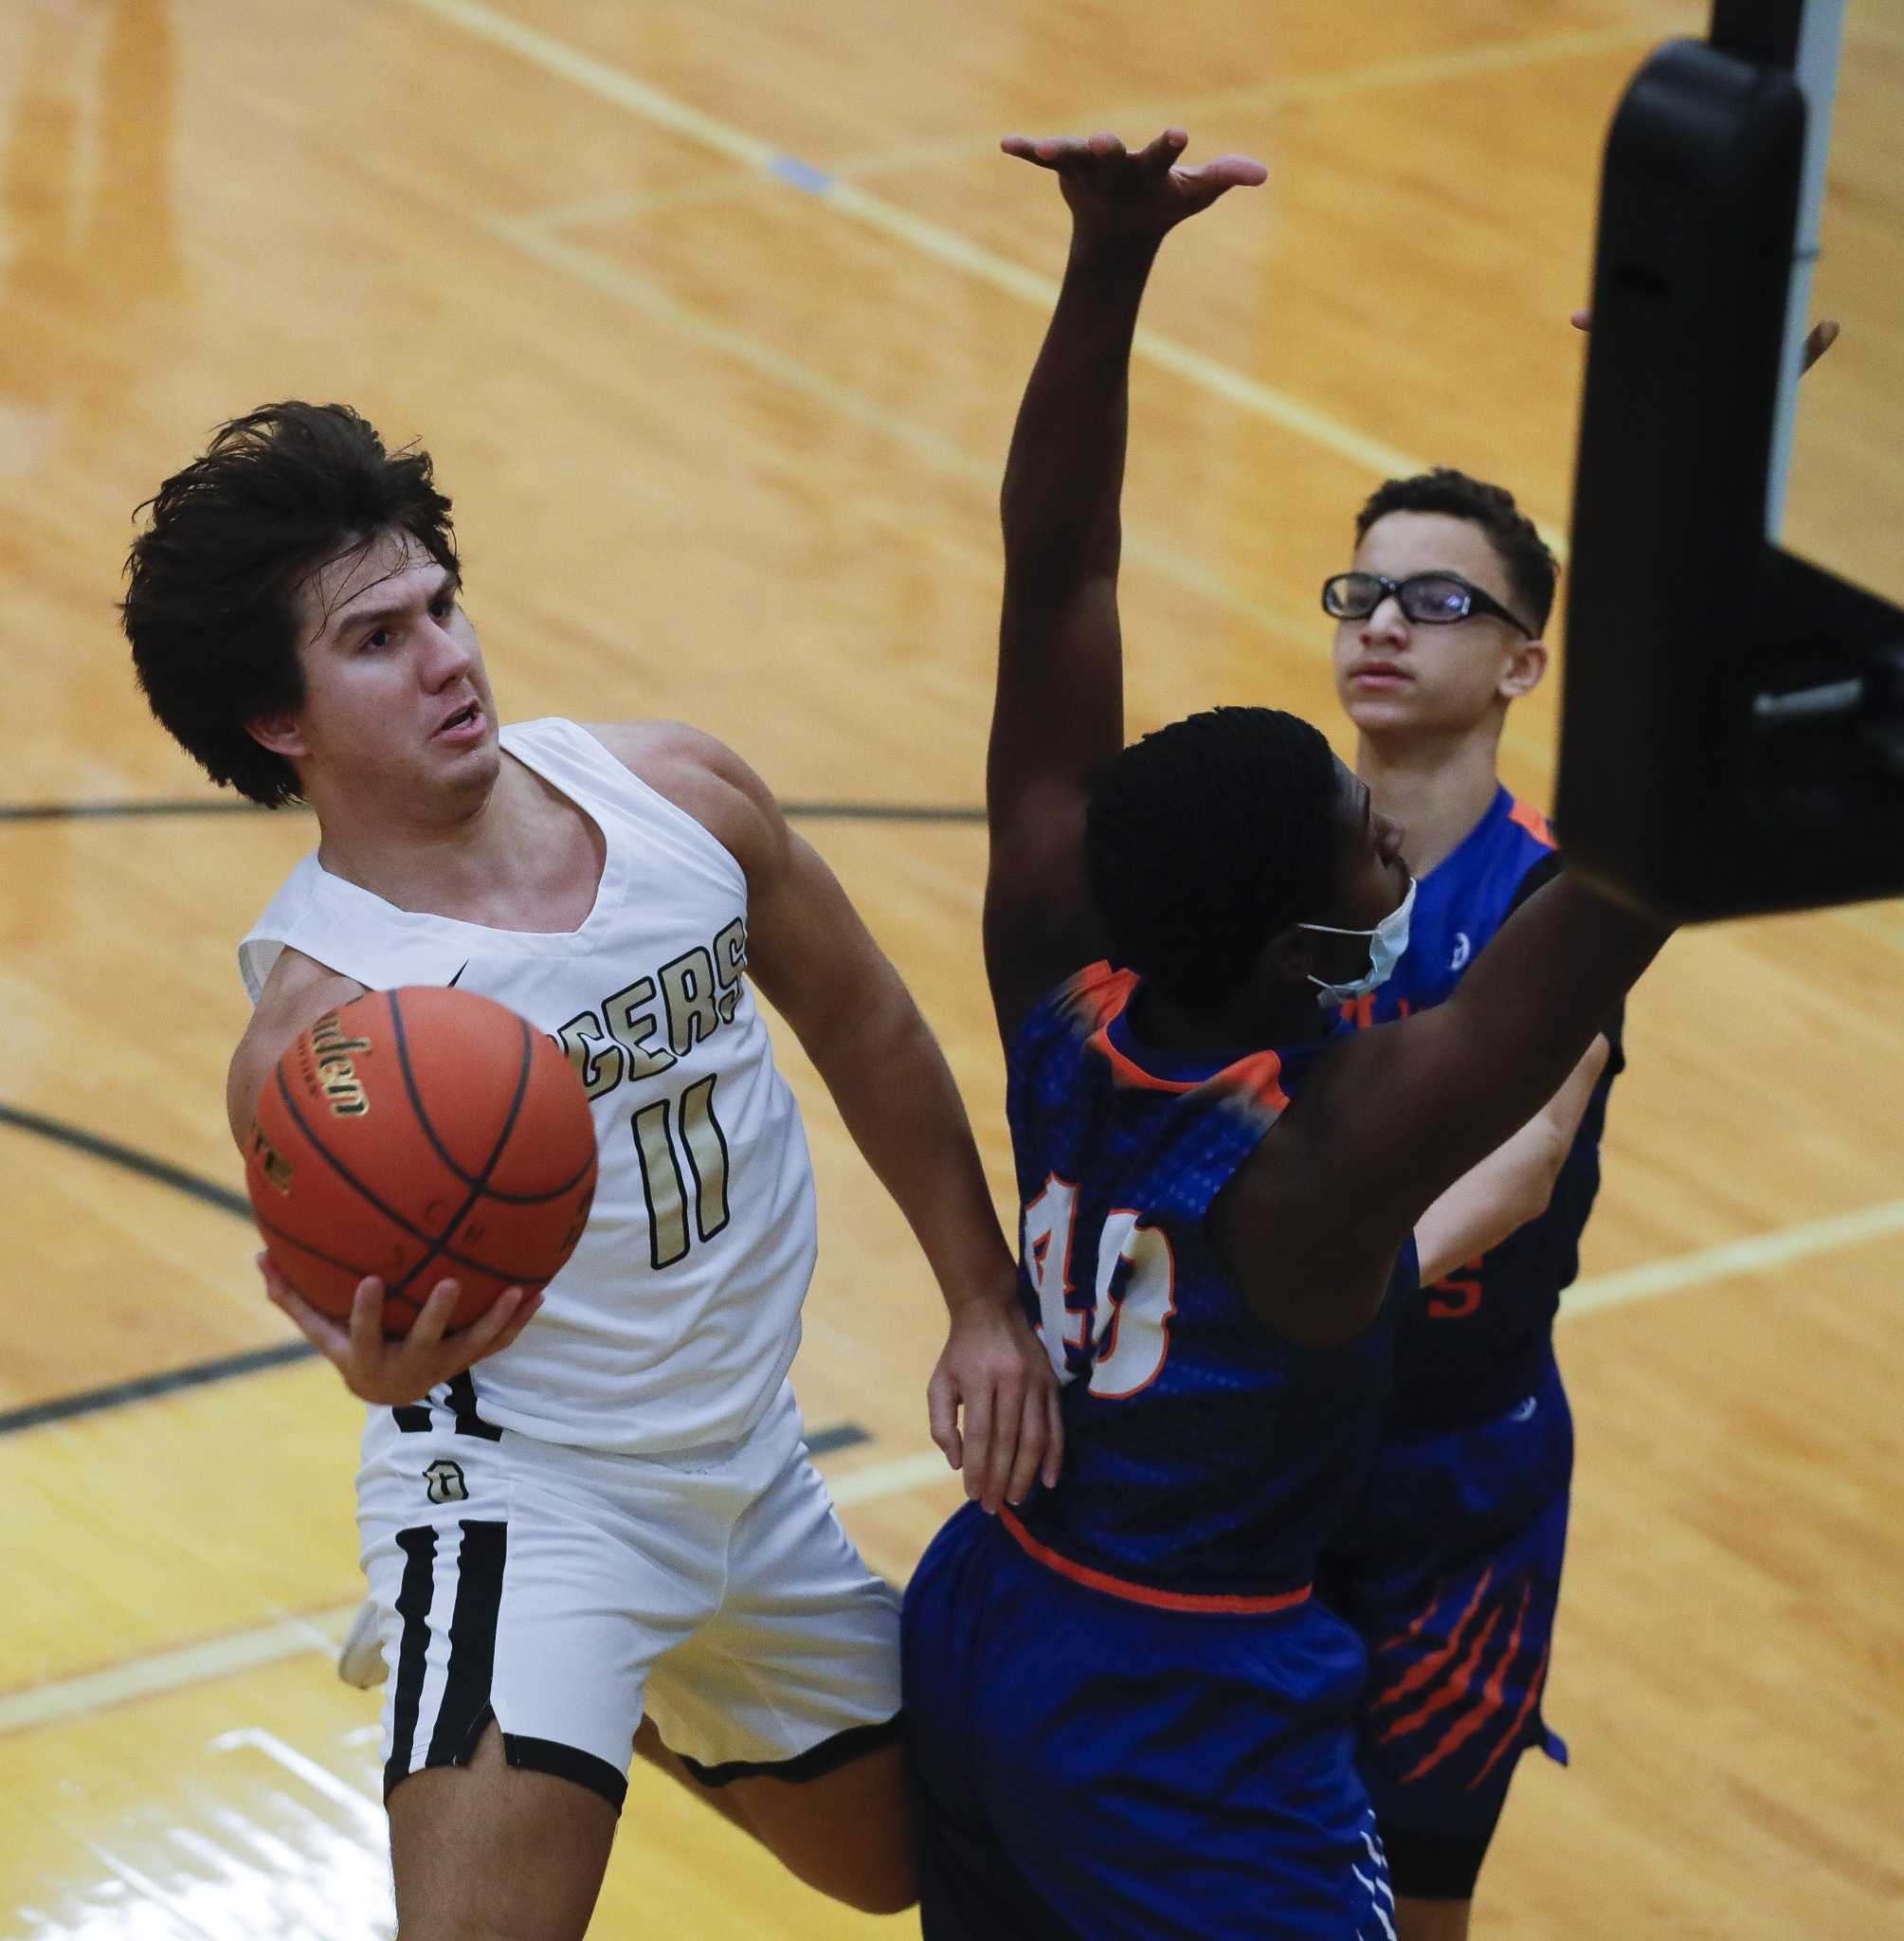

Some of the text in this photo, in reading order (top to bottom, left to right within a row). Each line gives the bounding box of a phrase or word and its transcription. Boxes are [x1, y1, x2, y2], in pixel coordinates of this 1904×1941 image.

[547, 916, 747, 1101] GERS
[630, 1073, 731, 1271] 11
[1024, 1170, 1178, 1401] 40
